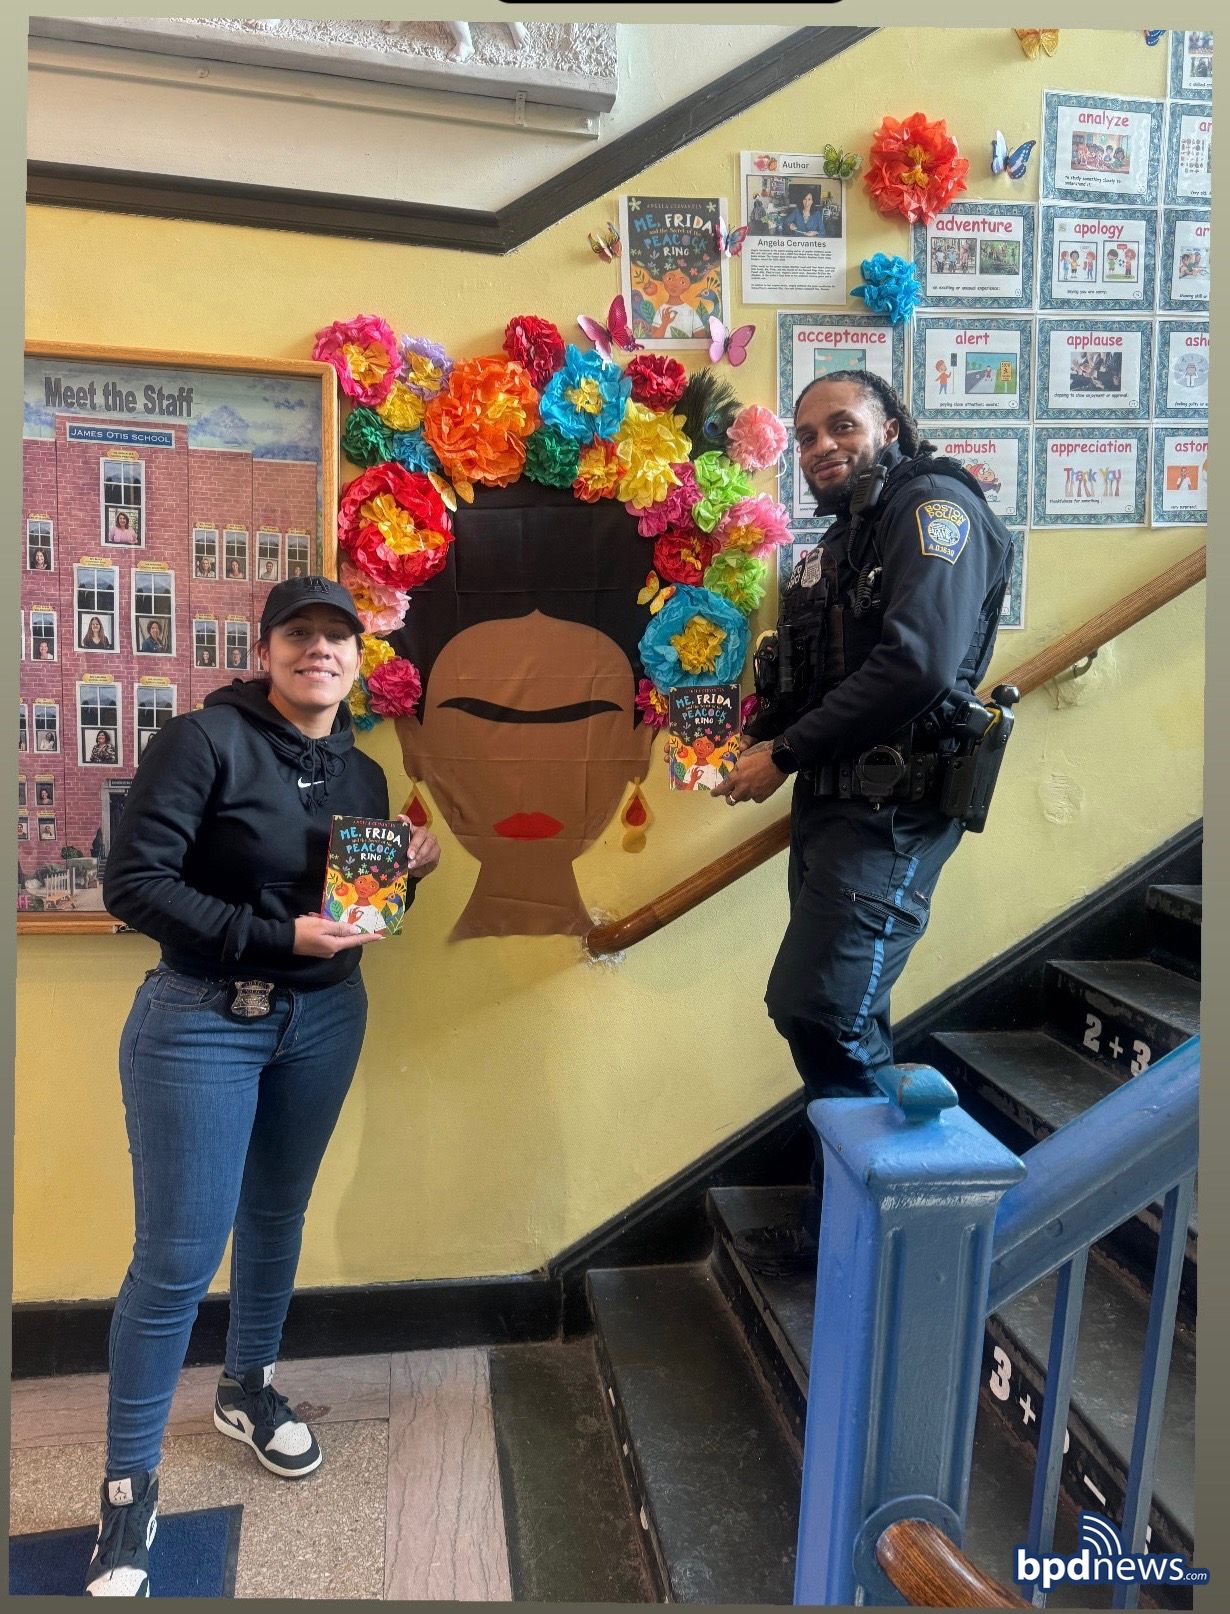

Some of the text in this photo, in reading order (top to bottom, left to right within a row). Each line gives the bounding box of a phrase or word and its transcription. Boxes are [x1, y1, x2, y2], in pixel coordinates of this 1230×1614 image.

[1078, 110, 1130, 129] analyze
[782, 160, 810, 169] Author
[664, 213, 714, 236] FRIDA,
[936, 216, 1012, 232] adventure
[1074, 220, 1124, 239] apology
[644, 234, 708, 250] PEACOCK
[758, 239, 826, 248] Angela Cervantes
[663, 246, 690, 256] RING
[798, 329, 886, 347] acceptance
[956, 331, 990, 344] alert
[1066, 332, 1124, 350] applause
[44, 376, 194, 417] Meet the Staff
[71, 428, 170, 443] JAMES OTIS SCHOOL
[944, 440, 996, 454] ambush
[1051, 440, 1132, 457] appreciation
[924, 504, 966, 523] BOSTON
[928, 510, 962, 526] POLICE
[696, 694, 732, 709] FRIDA,
[682, 708, 727, 720] PEACOCK
[365, 827, 402, 848] FRIDA,
[346, 843, 397, 857] PEACOCK
[360, 853, 382, 861] RING
[1083, 1013, 1102, 1053] 2
[1130, 1040, 1152, 1078] 3
[990, 1346, 1012, 1400] 3
